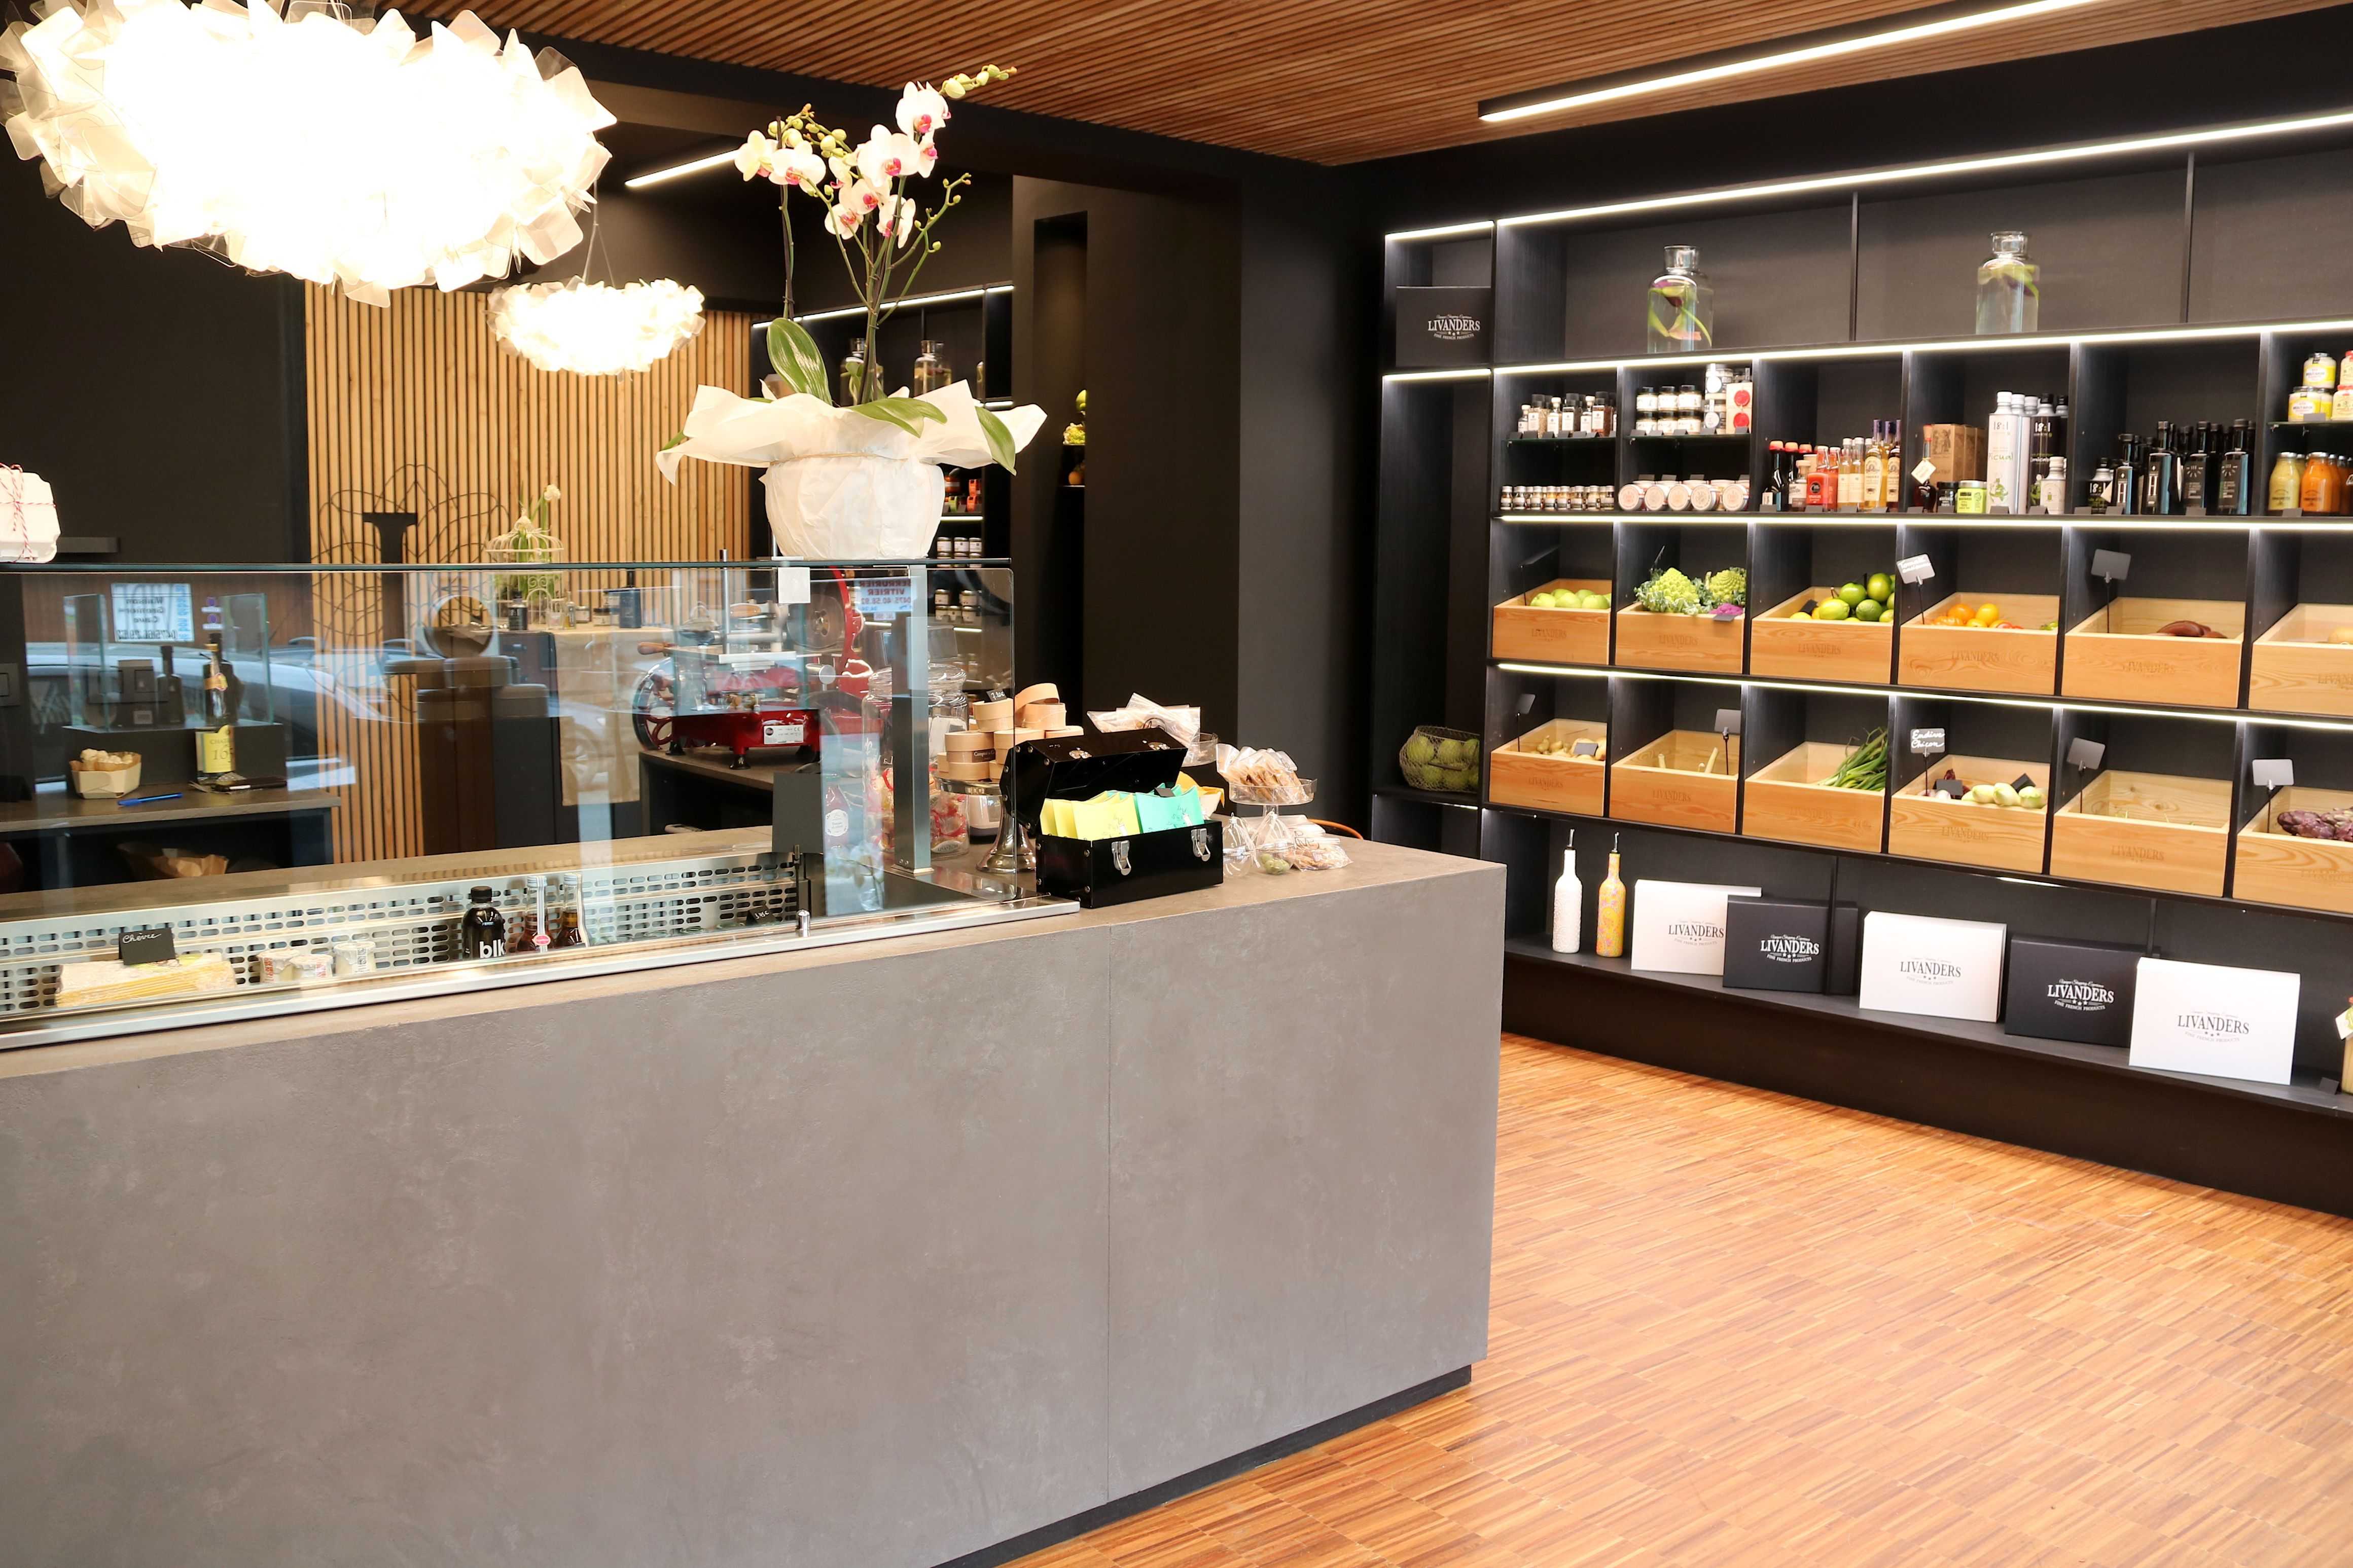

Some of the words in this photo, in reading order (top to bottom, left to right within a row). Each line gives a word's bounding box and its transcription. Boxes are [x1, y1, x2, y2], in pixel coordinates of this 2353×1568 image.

[1428, 319, 1481, 331] LIVANDERS
[2035, 422, 2050, 432] 18:1
[1797, 643, 1841, 655] LIVANDERS
[1912, 730, 1945, 739] Endive
[2111, 845, 2165, 861] LIVANDERS
[123, 933, 161, 943] Chèvre
[1668, 924, 1724, 938] LIVANDERS
[479, 939, 505, 959] blk
[1760, 939, 1820, 955] LIVANDERS
[1900, 961, 1961, 977] LIVANDERS
[2047, 984, 2114, 1003] LIVANDERS
[2178, 1015, 2250, 1035] LIVANDERS
